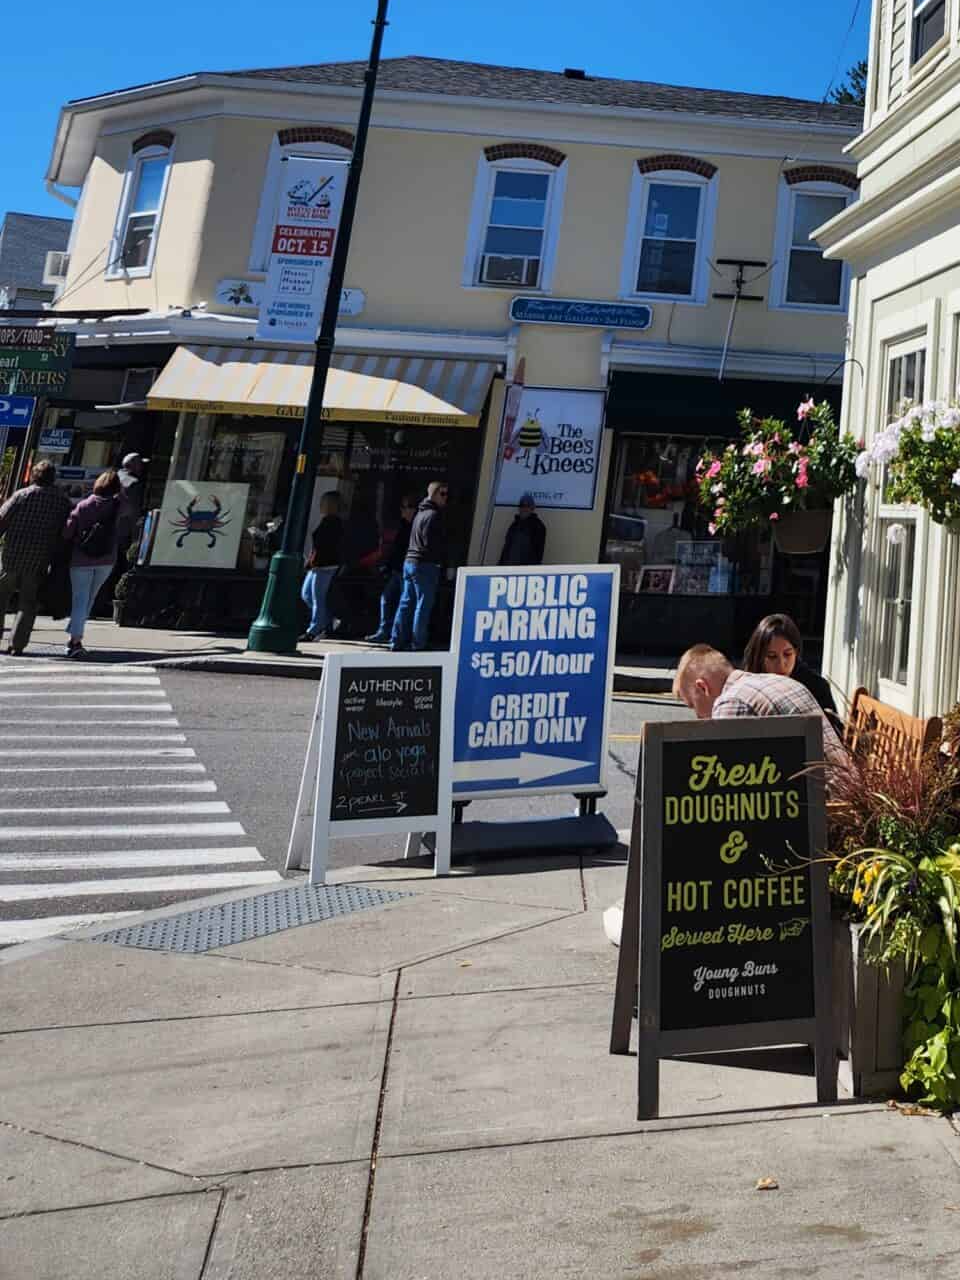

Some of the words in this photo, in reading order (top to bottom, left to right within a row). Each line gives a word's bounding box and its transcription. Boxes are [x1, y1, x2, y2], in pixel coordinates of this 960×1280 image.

[277, 238, 307, 253] OCT.
[311, 240, 328, 255] 15
[279, 227, 332, 238] CELEBRATION
[0, 328, 43, 344] OPS/FOOD
[0, 355, 19, 368] earl
[557, 423, 583, 439] The
[549, 437, 594, 455] Bee's
[532, 454, 594, 475] Knees
[487, 574, 589, 608] PUBLIC
[473, 608, 596, 642] PARKING
[471, 650, 594, 678] $5.50/hour
[348, 679, 423, 693] AUTHENTIC
[489, 691, 569, 721] CREDIT
[467, 720, 530, 748] CARD
[533, 716, 587, 744] ONLY
[689, 755, 782, 791] Fresh
[665, 790, 800, 825] DOUGHNUTS
[719, 830, 748, 864] &
[667, 880, 713, 912] HOT
[723, 875, 806, 909] COFFEE
[661, 925, 725, 952] Served
[727, 922, 774, 943] Here
[693, 965, 739, 992] Young
[741, 960, 779, 977] Buns
[708, 983, 766, 1000] DOUGHNUTS
